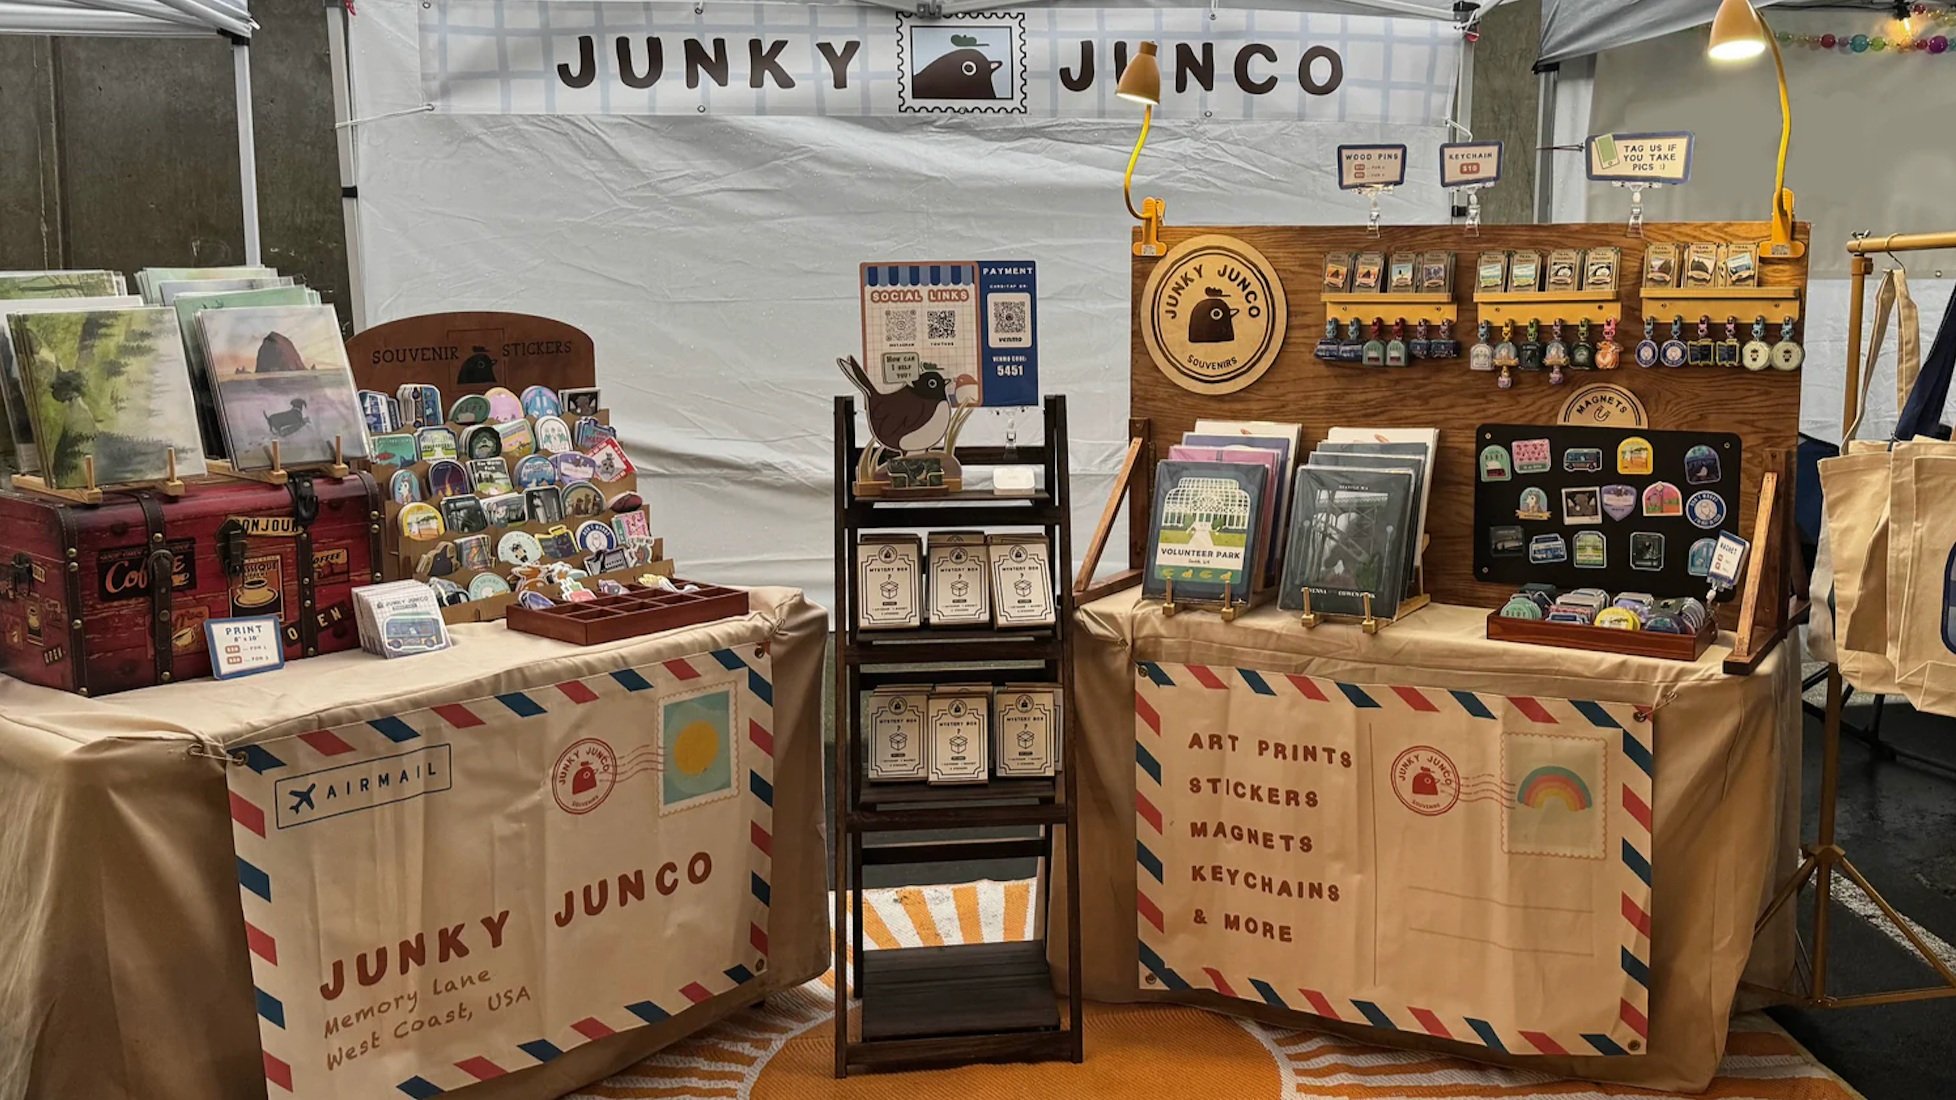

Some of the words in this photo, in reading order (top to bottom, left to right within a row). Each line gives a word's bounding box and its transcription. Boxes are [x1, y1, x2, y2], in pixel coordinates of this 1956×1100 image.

[557, 35, 860, 90] JUNKY
[1449, 152, 1493, 160] KEYCHAIN
[1623, 154, 1643, 162] YOU
[1650, 153, 1676, 161] TAKE
[1624, 144, 1644, 153] TAG
[1650, 144, 1662, 152] US
[1667, 143, 1677, 152] IF
[1632, 163, 1654, 171] PICS
[982, 267, 1033, 275] PAYMENT
[871, 289, 923, 302] SOCIAL
[928, 289, 969, 301] LINKS
[1165, 264, 1203, 319] JUNKY
[1217, 264, 1260, 318] JUNCO
[372, 346, 459, 364] SOUVENIR
[502, 340, 572, 357] STICKERS
[1187, 354, 1238, 370] SOUVENIRS
[996, 365, 1024, 377] 5451
[1576, 395, 1627, 415] MAGNETS
[312, 552, 340, 564] OFFEE
[1161, 548, 1213, 558] VOLUNTEER
[1216, 551, 1240, 559] PARK
[225, 625, 262, 635] PRINT
[287, 606, 342, 640] OEN
[1188, 732, 1239, 752] ART
[1258, 739, 1352, 768] PRINTS
[326, 762, 437, 800] AIRMAIL
[559, 749, 580, 786] JUNKY
[585, 747, 610, 772] JUNCO
[1398, 754, 1420, 781] JUNKY
[1426, 756, 1452, 786] JUNCO
[1189, 777, 1319, 808] STICKERS
[1190, 821, 1313, 853] MAGNETS
[1191, 865, 1340, 902] KEYCHAINS
[320, 910, 509, 1000] JUNKY
[554, 851, 713, 928] JUNCO
[1193, 908, 1208, 925] &
[1224, 913, 1293, 943] MORE
[323, 990, 418, 1039] Memory
[433, 968, 492, 996] Lane
[327, 1035, 381, 1071] West
[394, 1002, 473, 1039] Coast,
[488, 985, 531, 1012] USA
